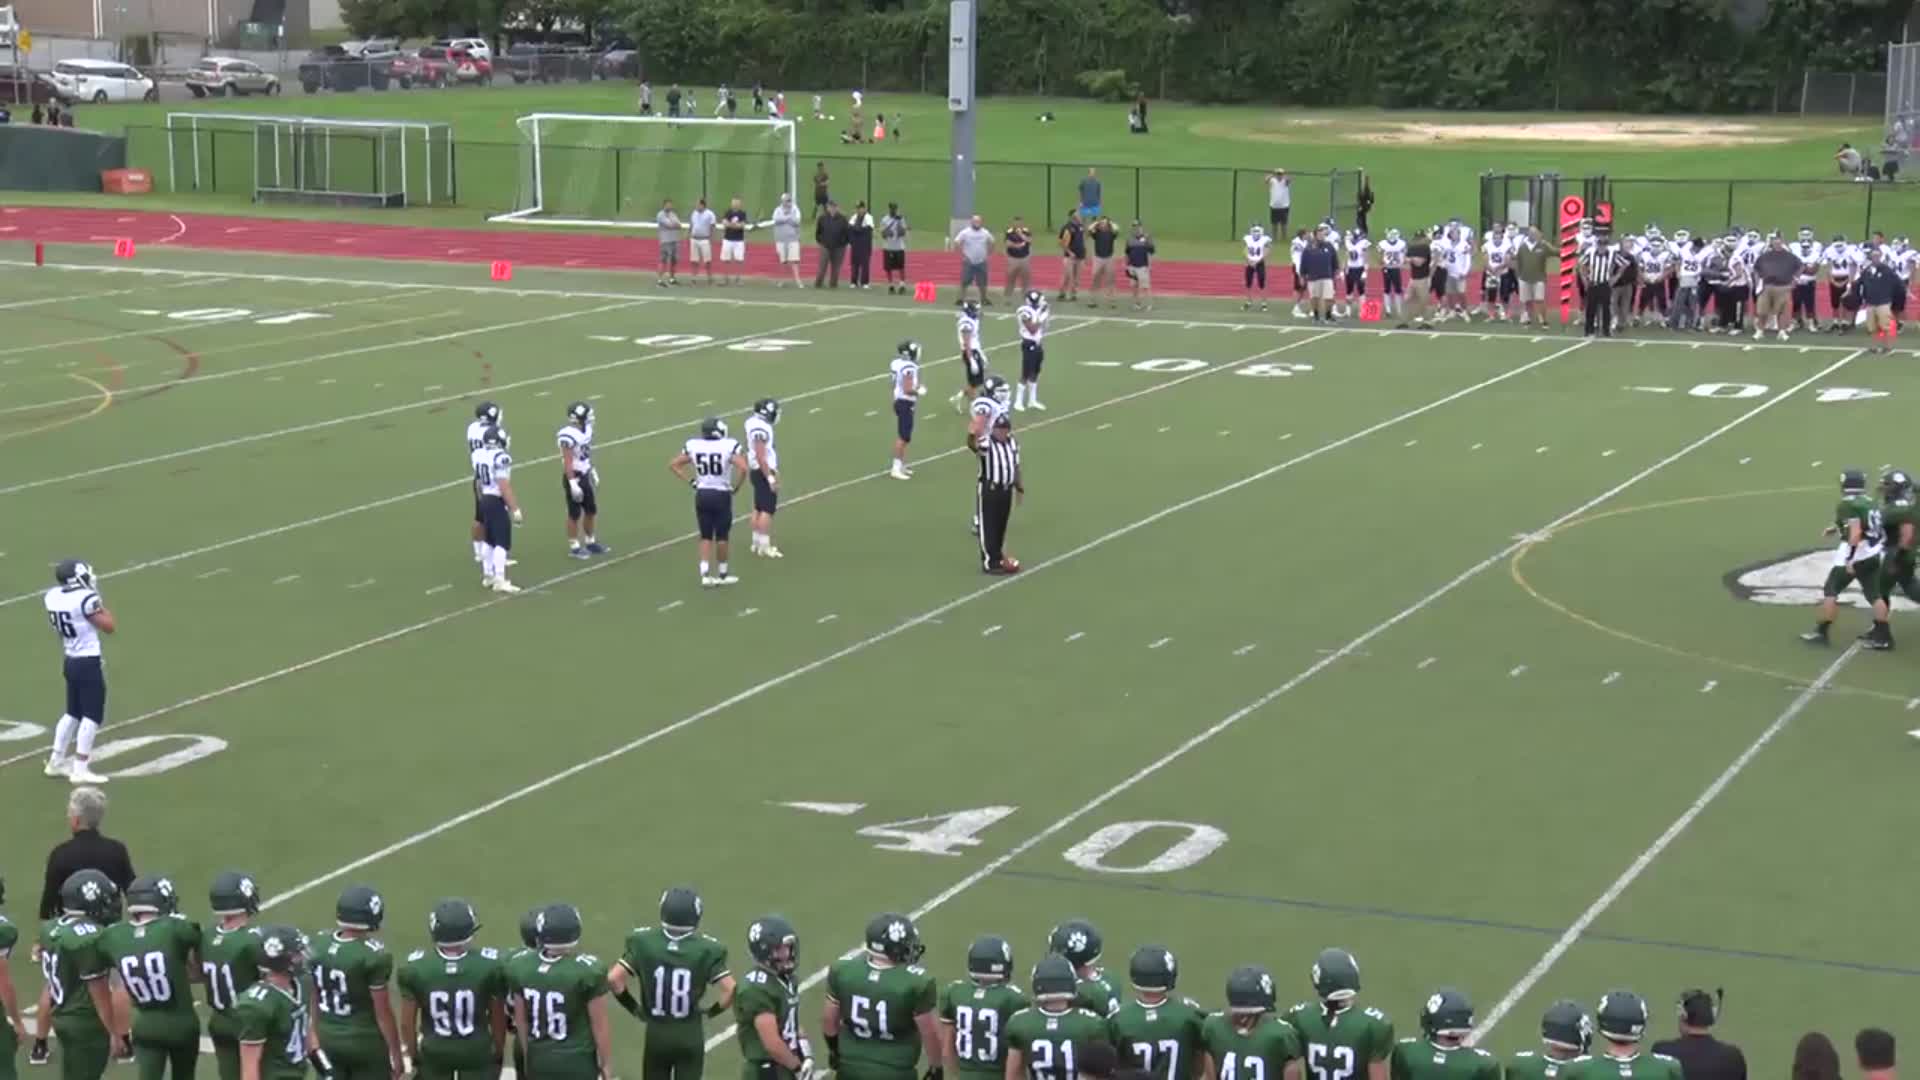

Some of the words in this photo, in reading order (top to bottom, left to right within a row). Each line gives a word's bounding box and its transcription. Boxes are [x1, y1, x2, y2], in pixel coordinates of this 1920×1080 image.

[120, 950, 172, 1003] 68
[202, 961, 238, 1010] 71
[314, 964, 351, 1016] 12
[651, 965, 692, 1018] 18
[524, 987, 567, 1041] 76
[851, 995, 894, 1041] 51
[955, 1005, 999, 1062] 83
[1031, 1039, 1074, 1080] 21
[1307, 1043, 1355, 1080] 52
